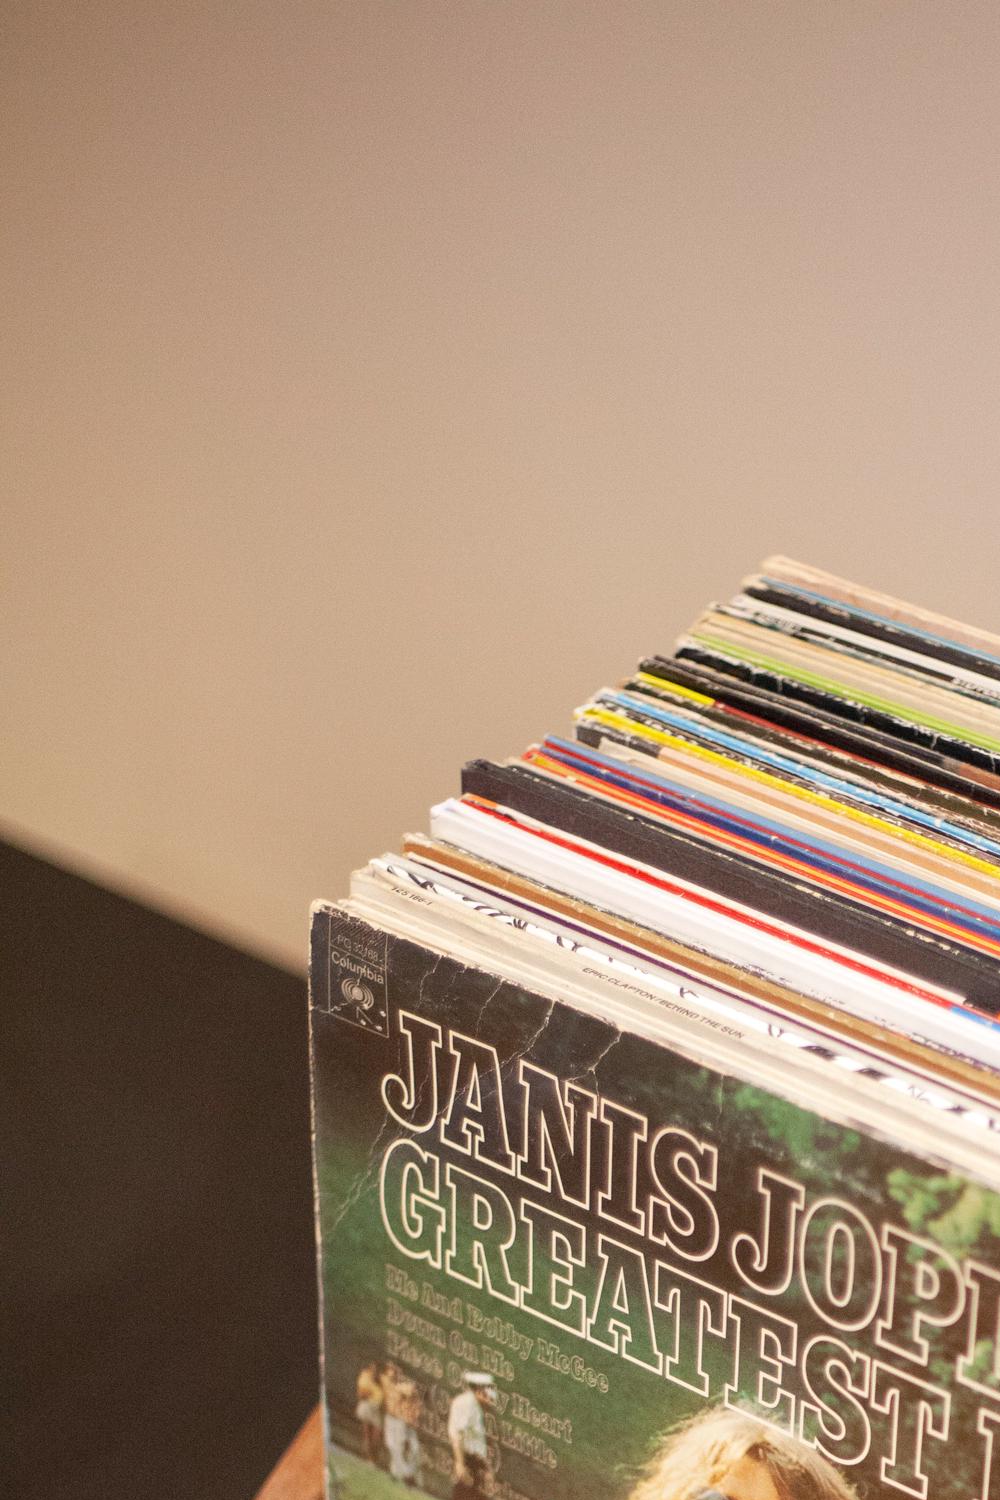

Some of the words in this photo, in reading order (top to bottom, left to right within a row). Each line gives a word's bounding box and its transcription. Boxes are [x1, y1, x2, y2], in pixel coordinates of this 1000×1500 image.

[331, 950, 384, 983] Columbia
[582, 966, 608, 980] ERIC
[700, 1016, 722, 1029] THE
[720, 1025, 745, 1039] SUN
[380, 1008, 720, 1262] JANIS
[379, 1138, 951, 1500] GREATEST
[385, 1263, 419, 1302] Me
[421, 1282, 464, 1324] And
[466, 1303, 534, 1361] Bobby
[536, 1337, 609, 1394] McGee
[386, 1297, 447, 1350] Down
[449, 1329, 480, 1366] On
[481, 1344, 515, 1382] Me
[512, 1391, 573, 1444] Heart
